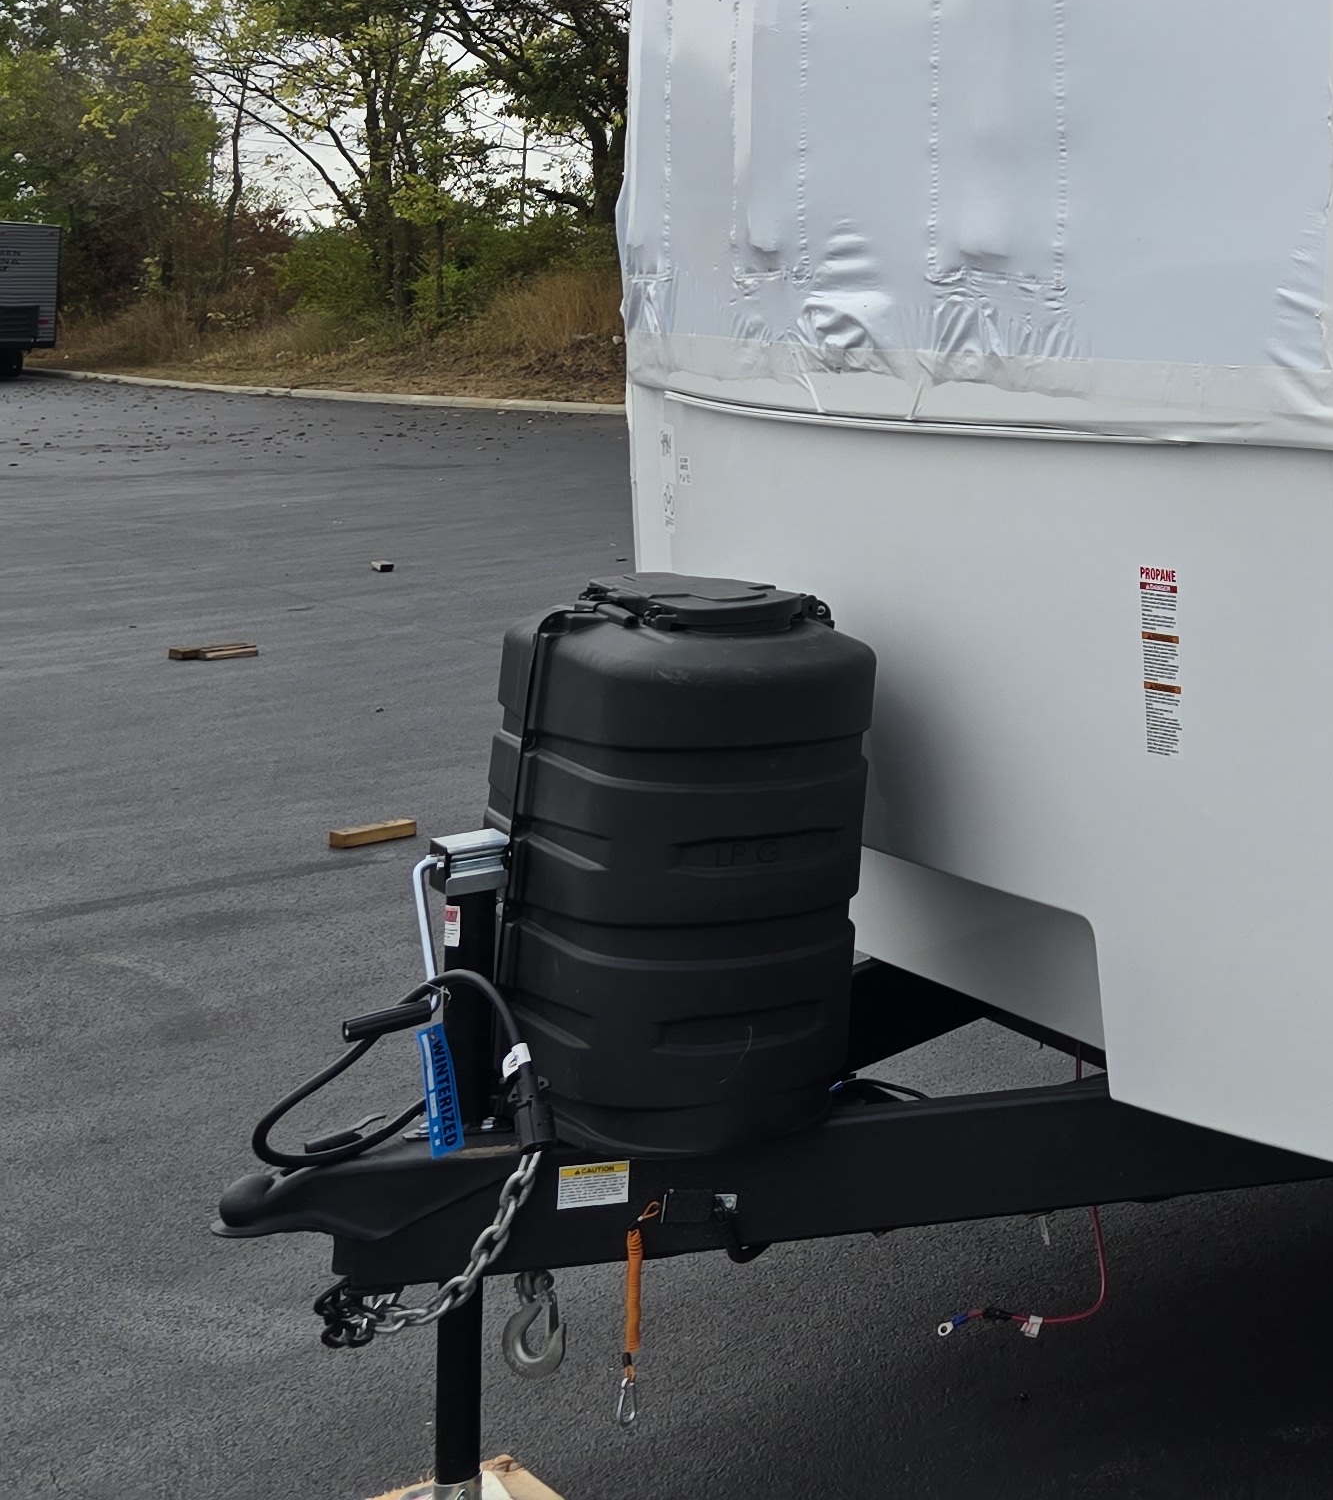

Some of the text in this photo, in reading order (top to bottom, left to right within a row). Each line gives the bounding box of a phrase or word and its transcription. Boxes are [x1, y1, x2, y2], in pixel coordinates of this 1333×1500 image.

[1139, 566, 1177, 583] PROPANE
[432, 1038, 459, 1147] WINTERIZED
[581, 1165, 615, 1175] CAUTION
